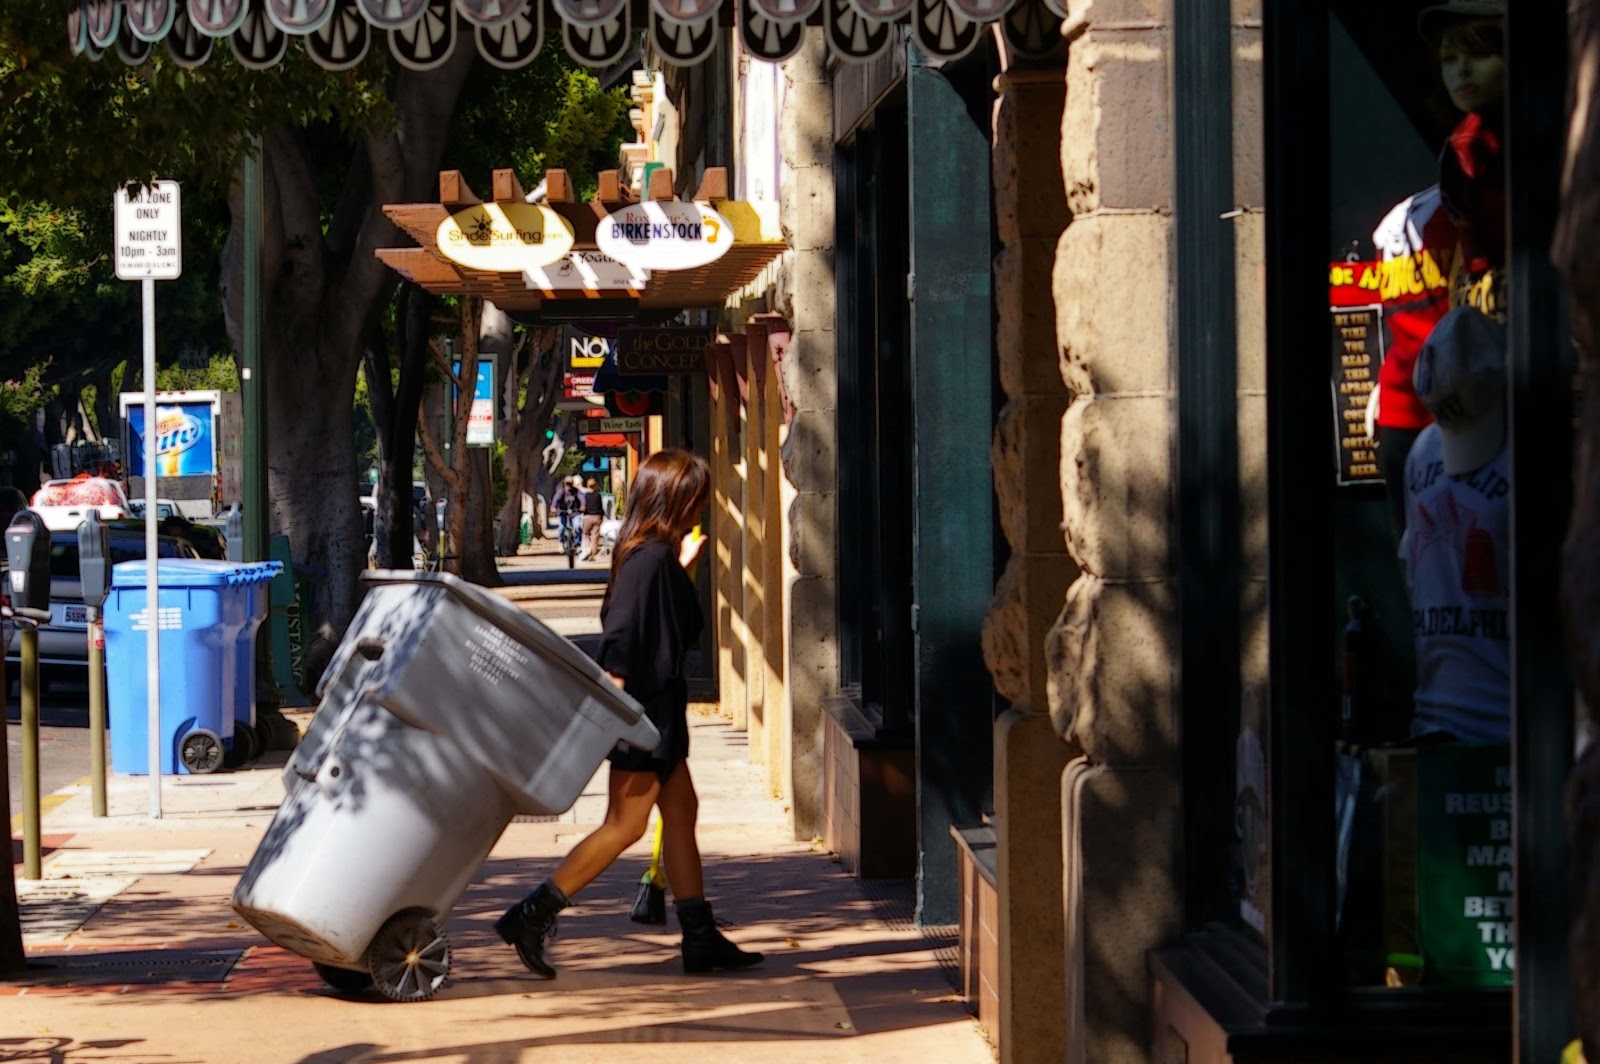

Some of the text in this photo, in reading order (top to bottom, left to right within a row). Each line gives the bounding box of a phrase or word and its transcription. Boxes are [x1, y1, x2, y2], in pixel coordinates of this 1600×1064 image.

[147, 193, 171, 204] ZONE
[136, 208, 160, 219] ONLY
[129, 231, 168, 242] NIGHTLY
[611, 223, 702, 241] BIRKENSTOCK
[121, 246, 145, 259] 10pm
[156, 246, 176, 257] 3am
[633, 335, 653, 351] the
[1341, 354, 1370, 367] READ
[603, 421, 623, 430] Wine
[154, 427, 195, 451] ite
[1490, 819, 1512, 841] B
